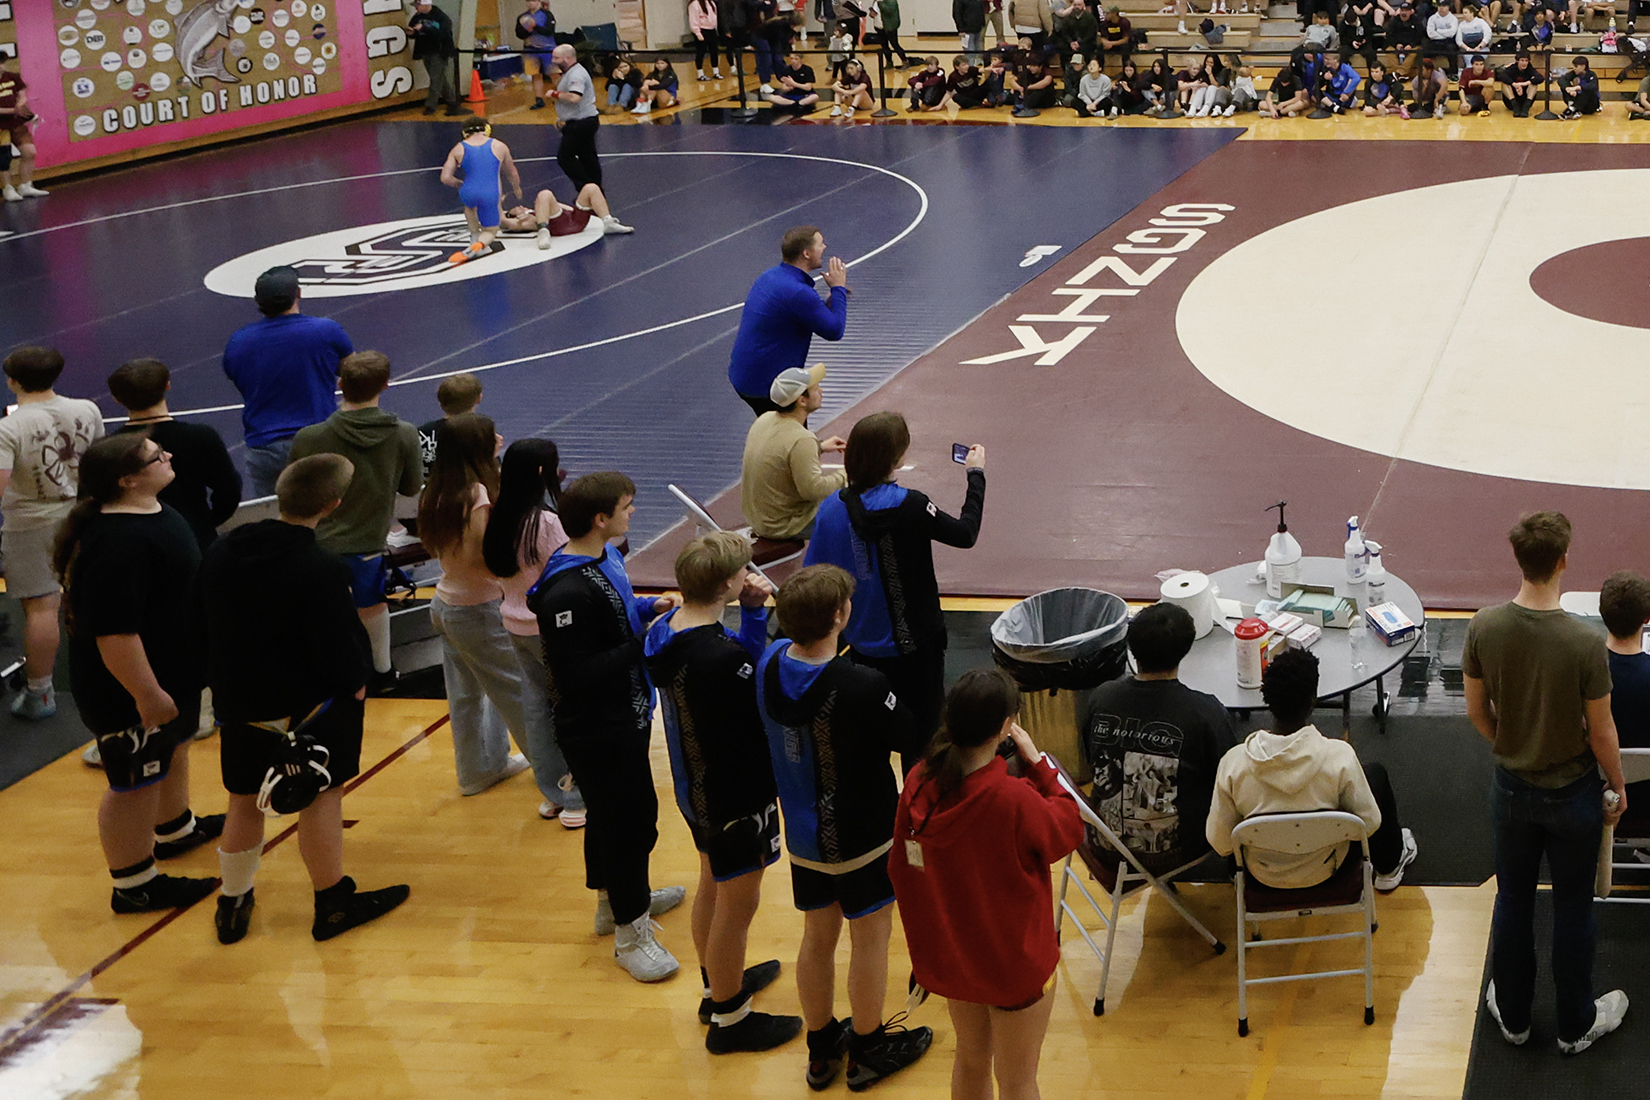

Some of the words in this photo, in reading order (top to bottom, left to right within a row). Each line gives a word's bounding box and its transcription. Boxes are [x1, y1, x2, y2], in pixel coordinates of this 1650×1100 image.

[103, 96, 189, 132] COURT
[202, 89, 227, 113] OF
[239, 74, 316, 106] HONOR
[958, 203, 1235, 365] KINGS
[1094, 724, 1108, 734] the
[1113, 728, 1174, 745] notorious
